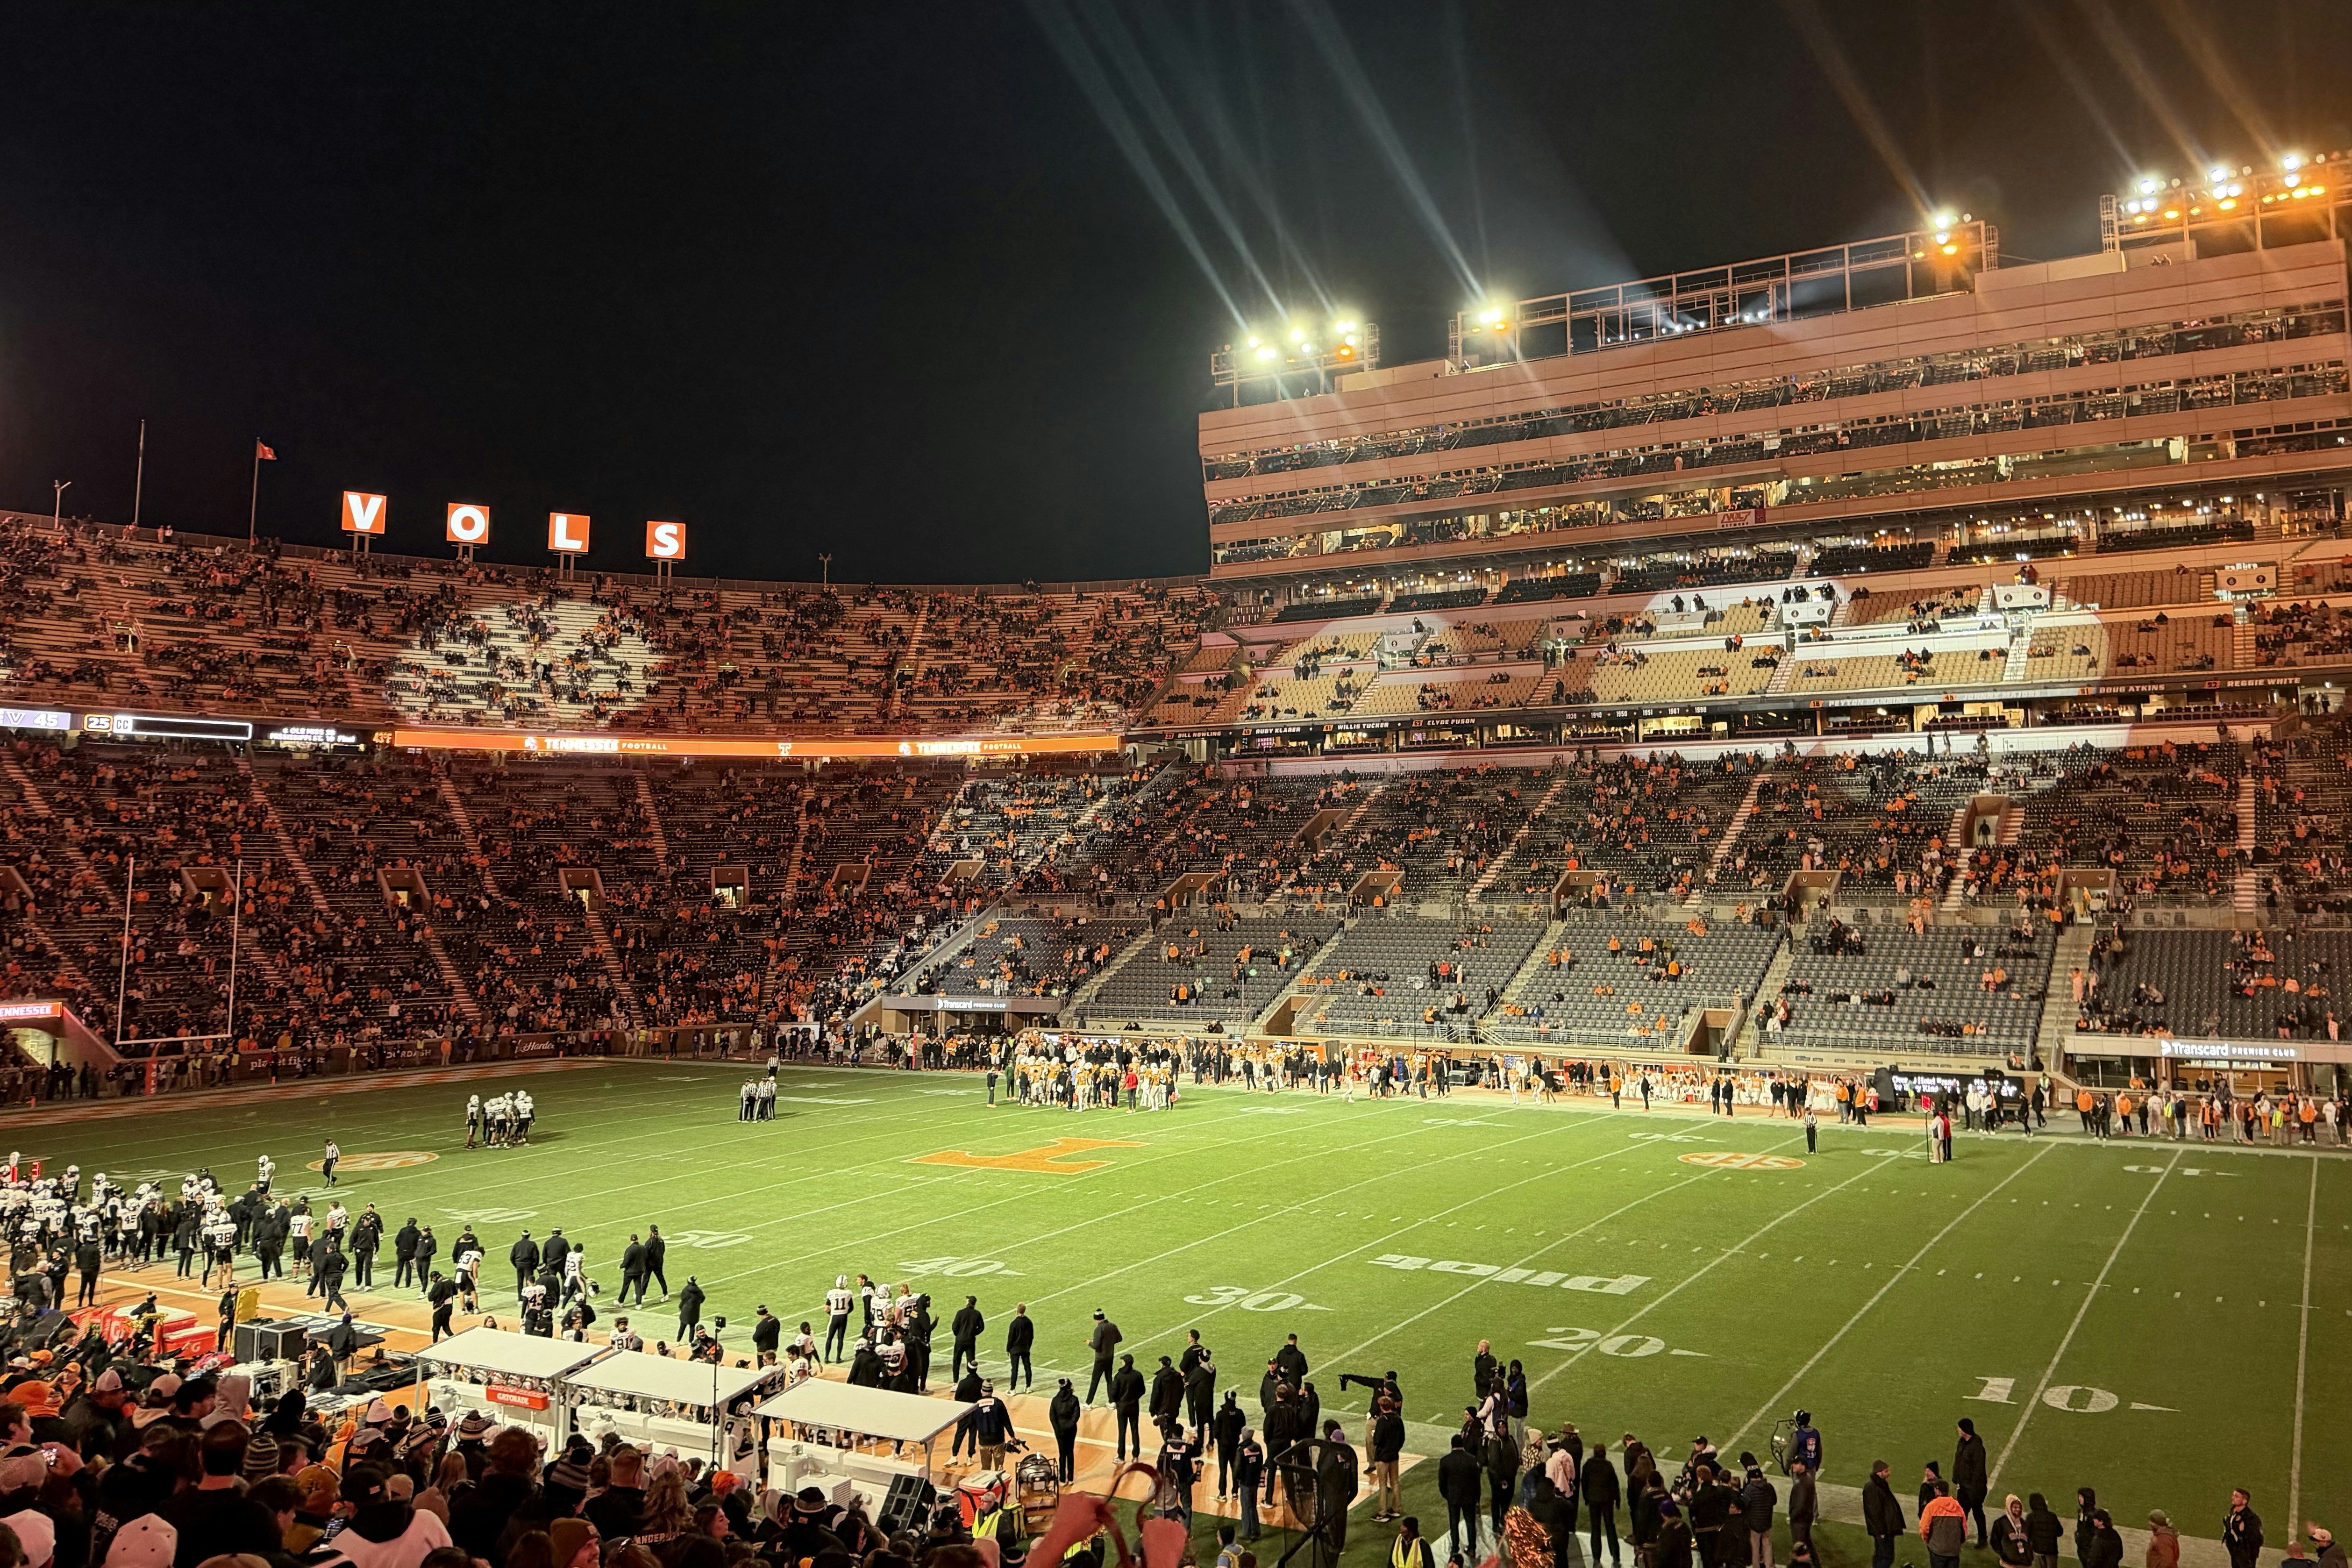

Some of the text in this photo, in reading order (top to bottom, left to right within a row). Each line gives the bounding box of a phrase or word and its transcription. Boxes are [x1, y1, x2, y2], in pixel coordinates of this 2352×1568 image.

[348, 494, 383, 529] V
[450, 506, 485, 540] O
[555, 516, 582, 549] L
[653, 524, 678, 556] S
[34, 714, 58, 727] 45
[88, 717, 111, 729] 25
[544, 739, 620, 751] TENNESSEE
[778, 742, 791, 755] T
[944, 1000, 973, 1008] Transcard
[2172, 1042, 2229, 1056] Transcard
[2272, 1048, 2295, 1056] CLUB
[125, 1215, 137, 1225] 45
[291, 1223, 303, 1234] 77
[215, 1232, 232, 1244] 38
[896, 1256, 1006, 1277] 40
[834, 1297, 846, 1311] 11
[1183, 1286, 1304, 1311] 30
[616, 1338, 630, 1349] 81
[1526, 1327, 1665, 1357] 20
[767, 1373, 784, 1390] 44
[497, 1392, 529, 1405] GATORADE
[1962, 1376, 2118, 1412] 10
[725, 1421, 734, 1434] 9
